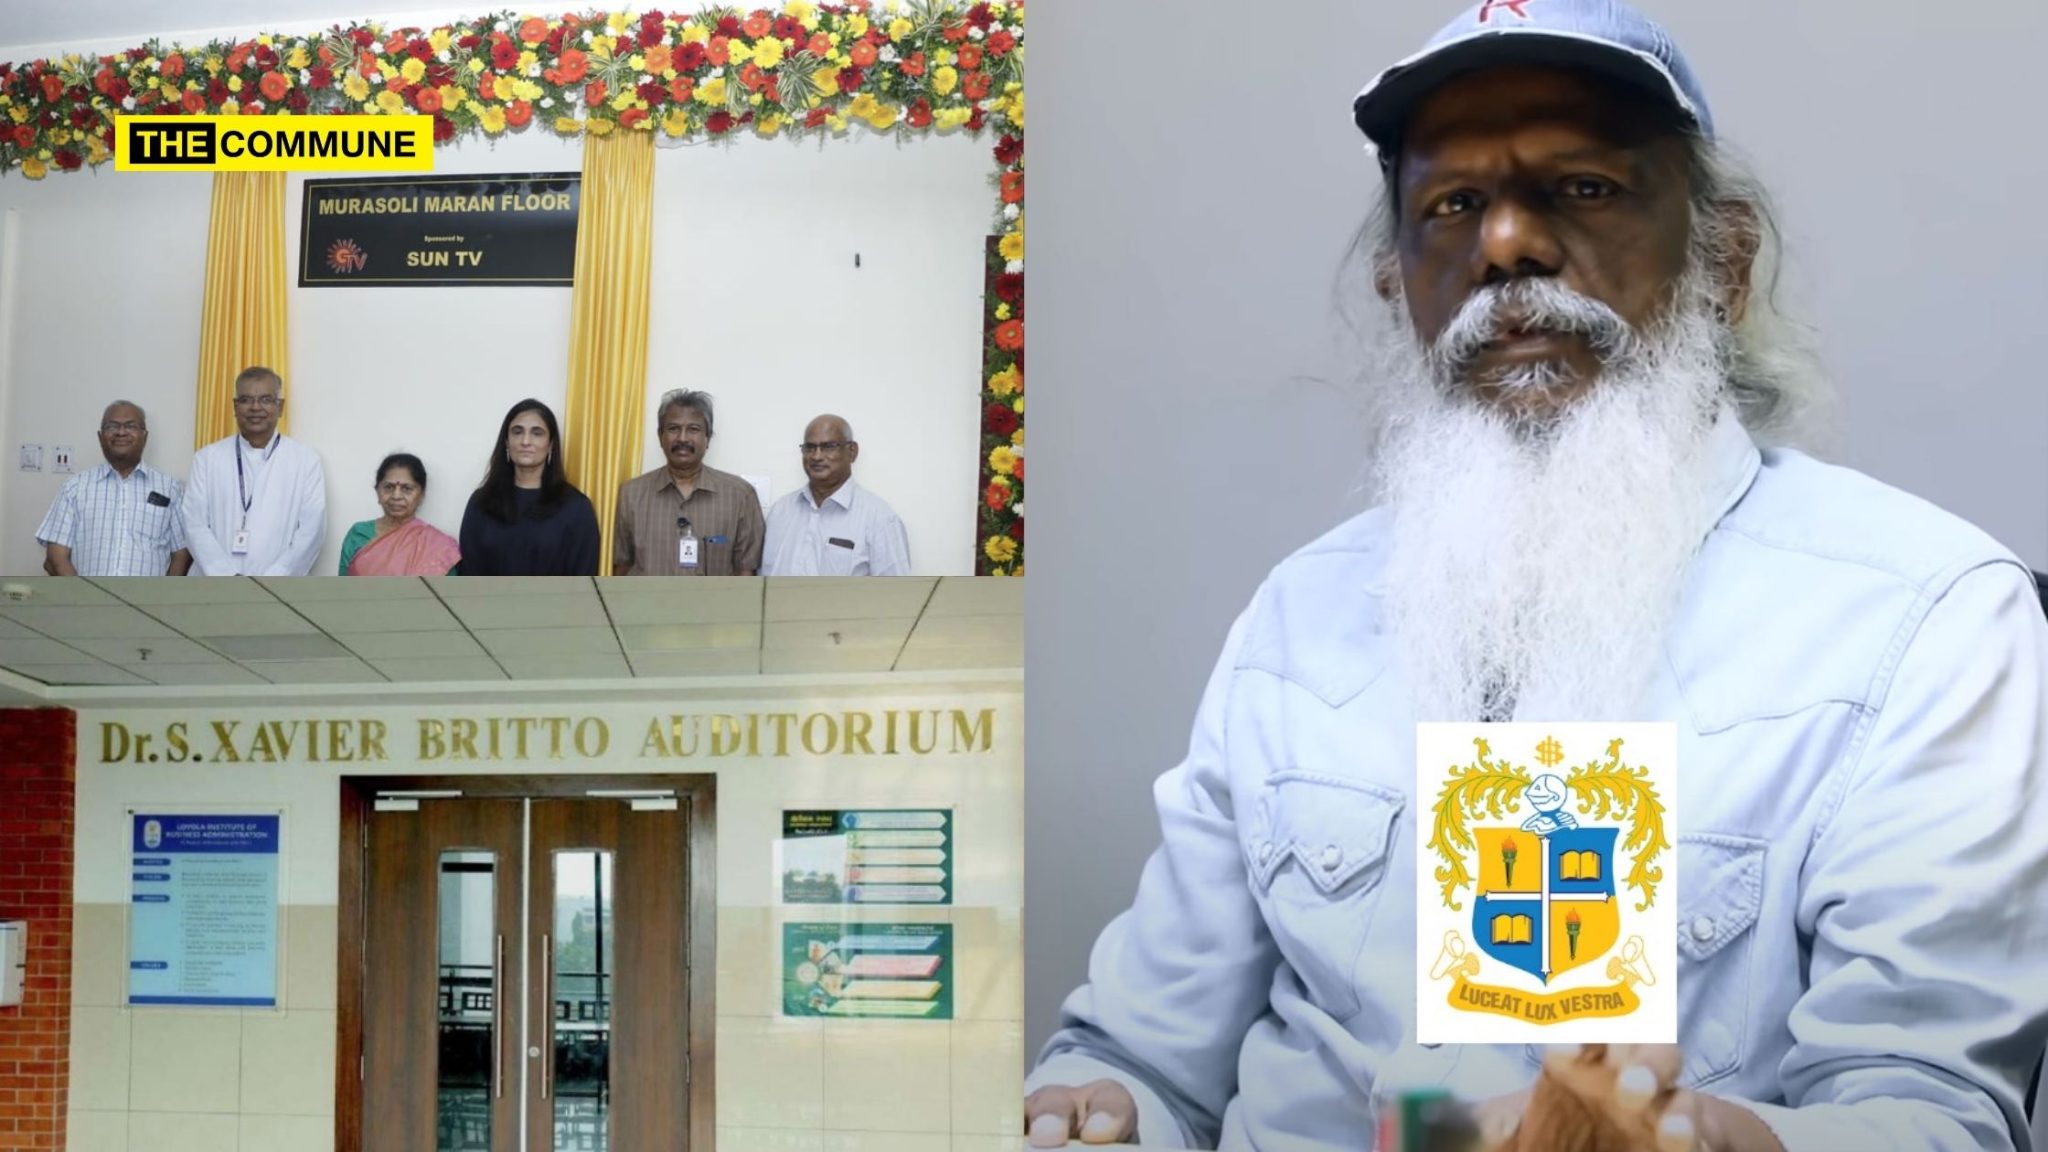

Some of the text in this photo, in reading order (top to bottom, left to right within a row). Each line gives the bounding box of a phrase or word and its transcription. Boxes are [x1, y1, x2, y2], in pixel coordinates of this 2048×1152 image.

[319, 194, 571, 215] MURASOLI MARAN FLOOR
[424, 235, 464, 244] Sponsored by
[407, 251, 483, 267] SUN TV
[417, 717, 610, 761] BRITTO
[638, 708, 997, 758] AUDITORIUM
[177, 823, 257, 831] LOYOLA INSTITUTE OF
[166, 831, 268, 839] BUSINESS ADMINISTRATION
